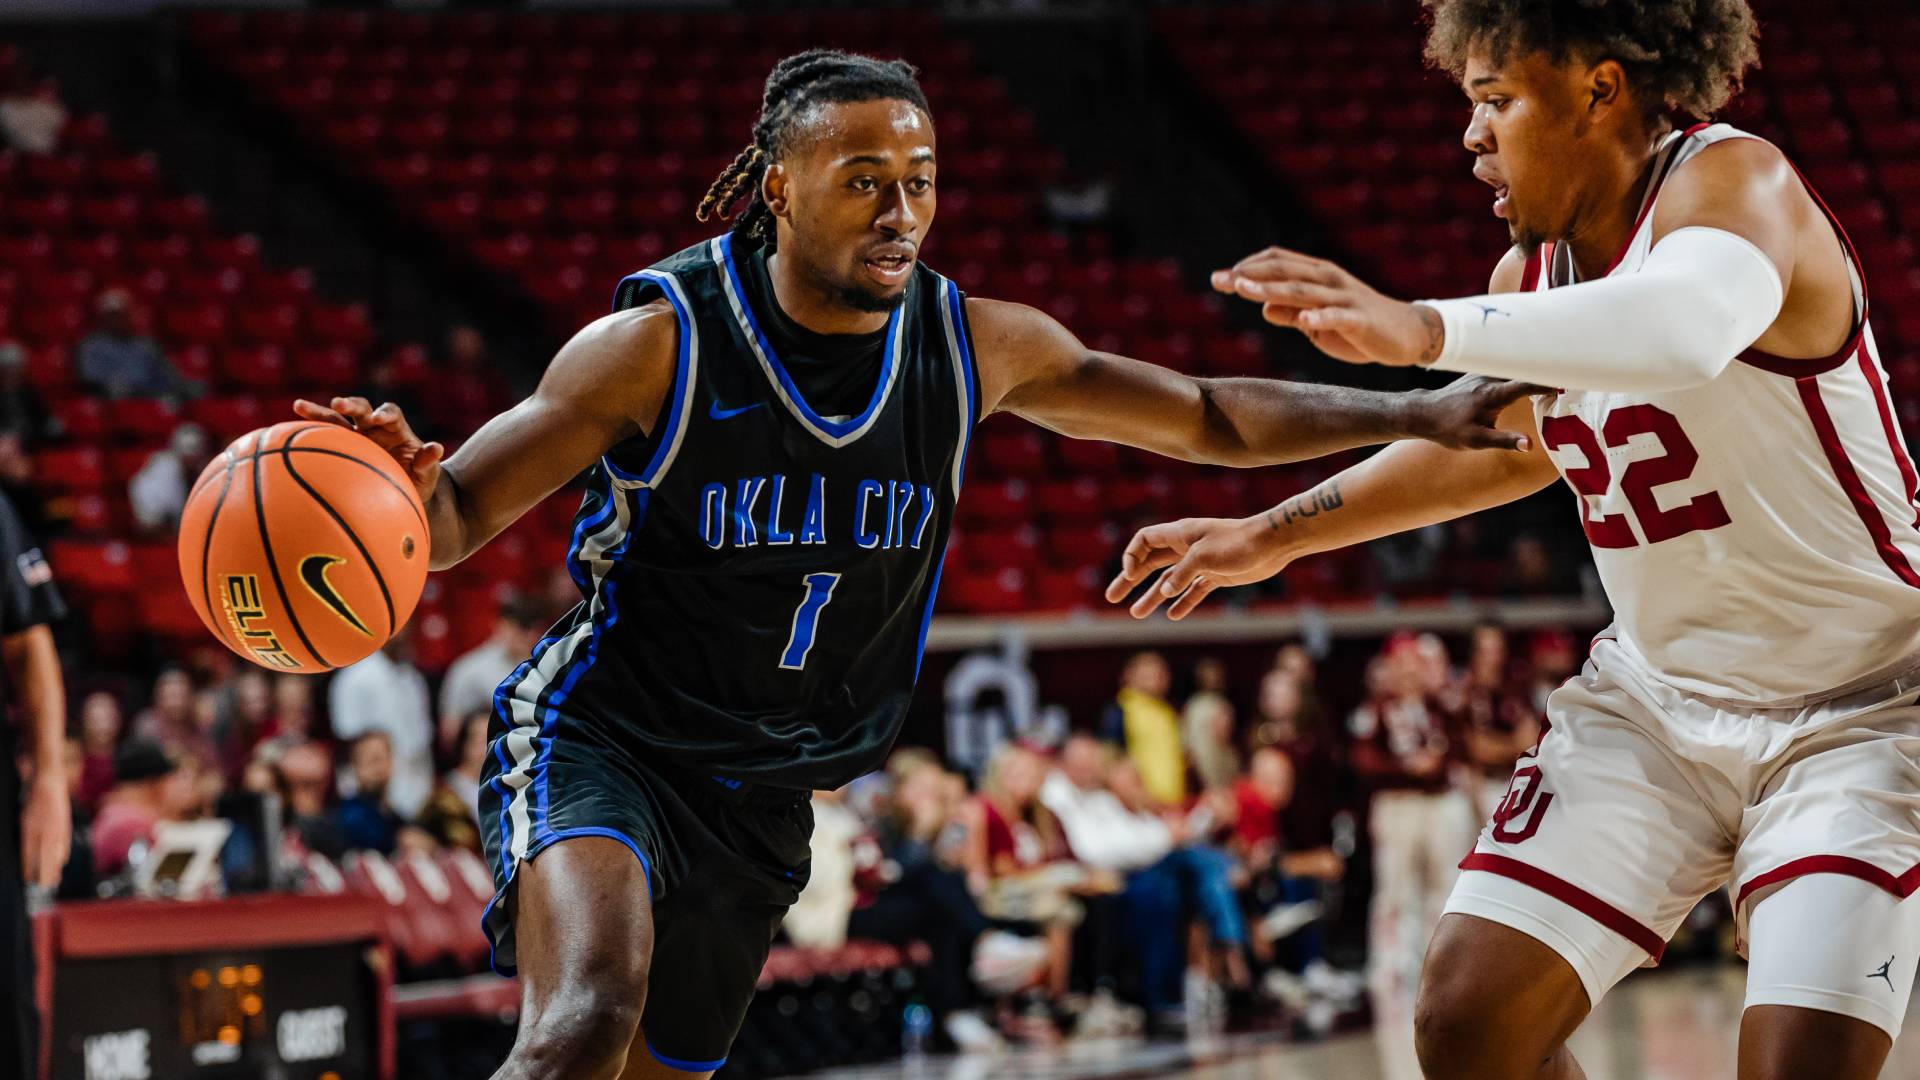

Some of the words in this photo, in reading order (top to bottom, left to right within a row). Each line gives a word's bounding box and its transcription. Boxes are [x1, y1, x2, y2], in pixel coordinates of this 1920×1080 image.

[699, 473, 827, 550] OKLA
[853, 479, 935, 550] CITY
[1542, 403, 1732, 550] 22
[225, 573, 304, 669] ELITE
[778, 571, 842, 671] 1
[1492, 765, 1554, 844] OU
